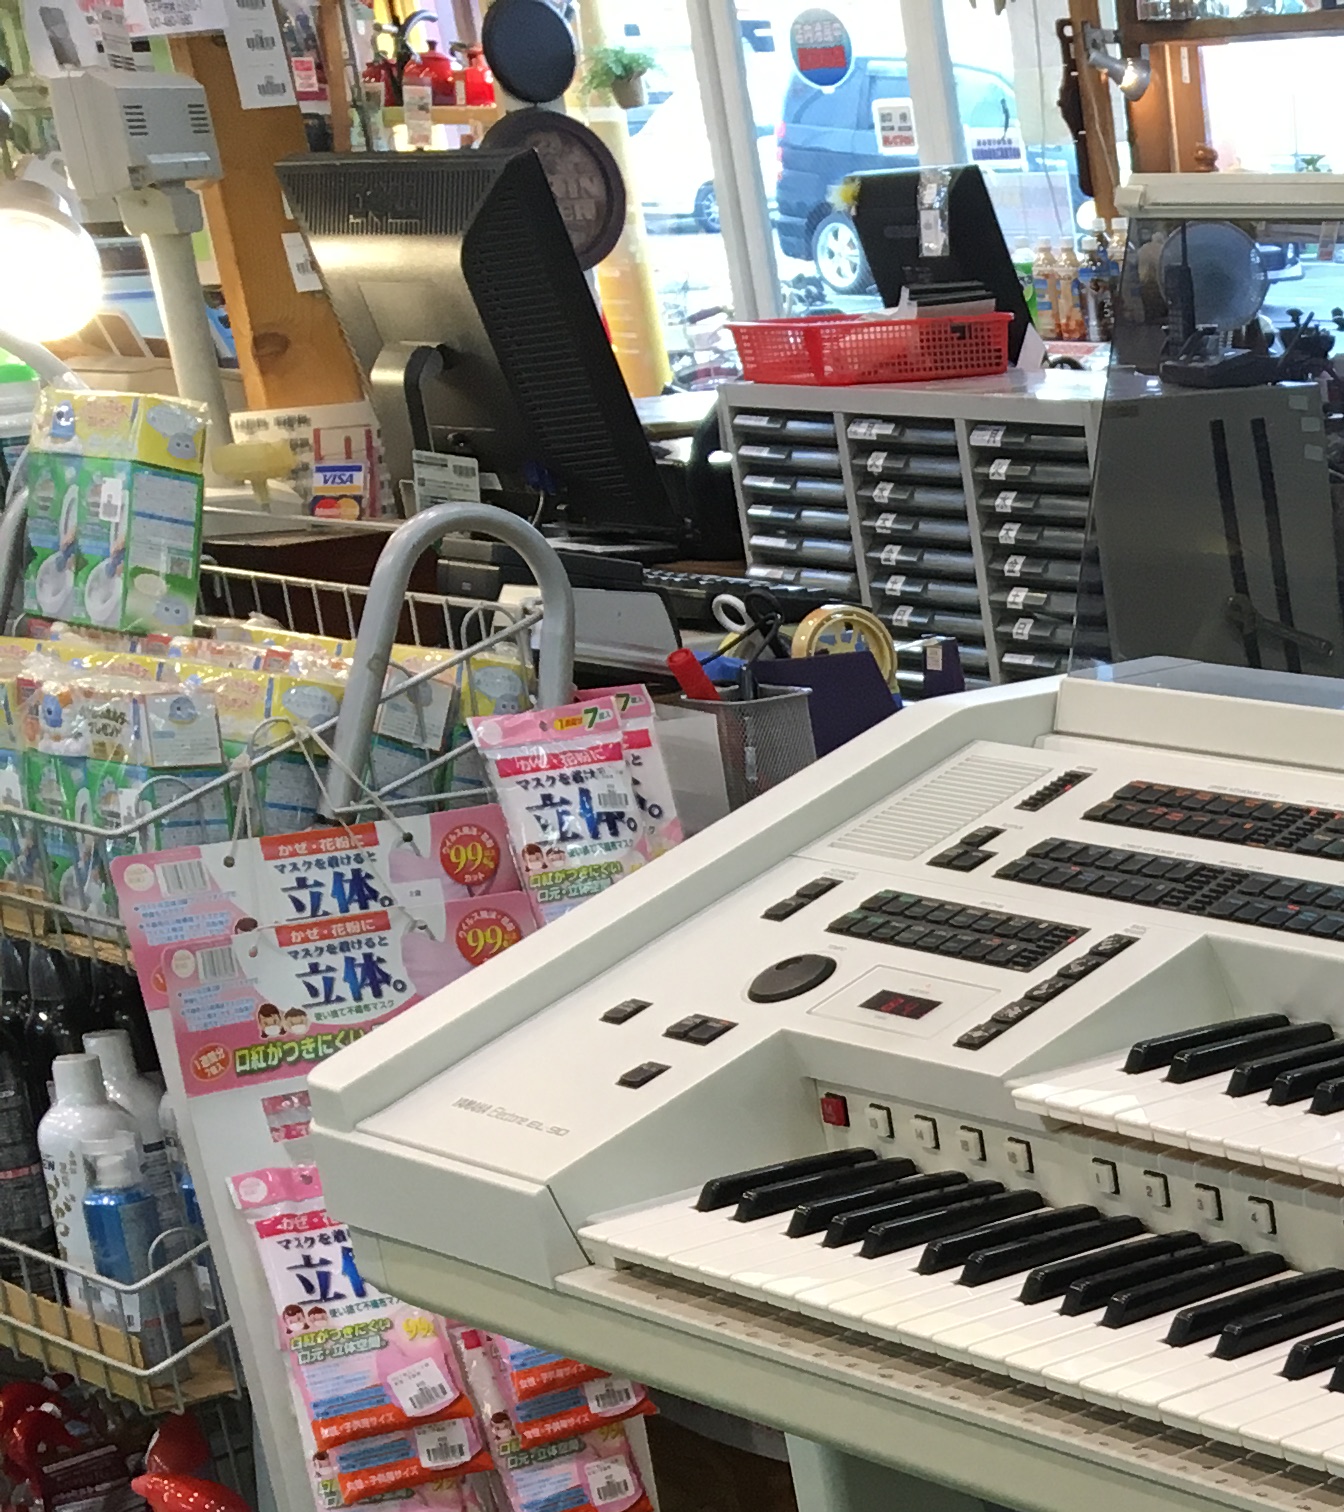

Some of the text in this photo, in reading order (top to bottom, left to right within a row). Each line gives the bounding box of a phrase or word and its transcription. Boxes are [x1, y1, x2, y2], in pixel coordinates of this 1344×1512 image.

[322, 473, 354, 485] VISA
[584, 707, 599, 729] 7
[278, 835, 364, 856] かぜ・花粉に
[449, 843, 481, 873] 99
[274, 852, 377, 874] マスクを着けると
[530, 861, 623, 888] 口紅がつきにくい
[281, 868, 394, 922] 立体。
[291, 919, 374, 944] かぜ・花粉に
[287, 936, 390, 960] マスクを着けると
[295, 952, 407, 1008] 立体。
[291, 1318, 391, 1350] 口紅がつきにくい
